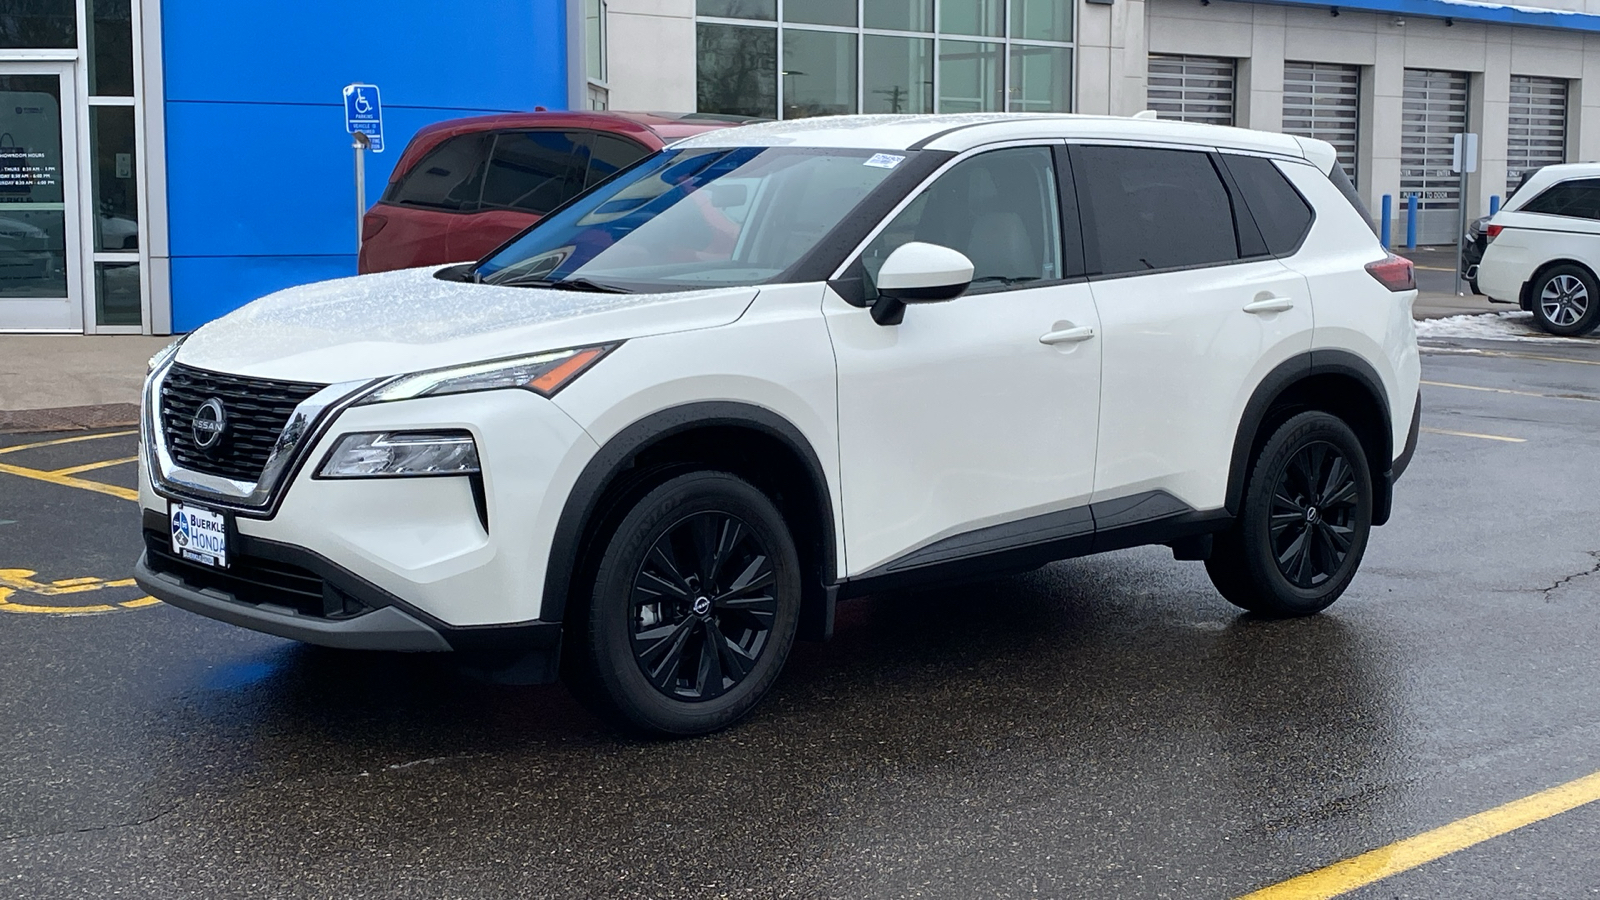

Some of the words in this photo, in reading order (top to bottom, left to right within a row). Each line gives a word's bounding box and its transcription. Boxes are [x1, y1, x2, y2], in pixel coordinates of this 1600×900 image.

[1426, 191, 1433, 199] TO
[1433, 191, 1448, 199] DOOR
[190, 514, 225, 533] BUERKLE
[190, 527, 226, 553] HONDA
